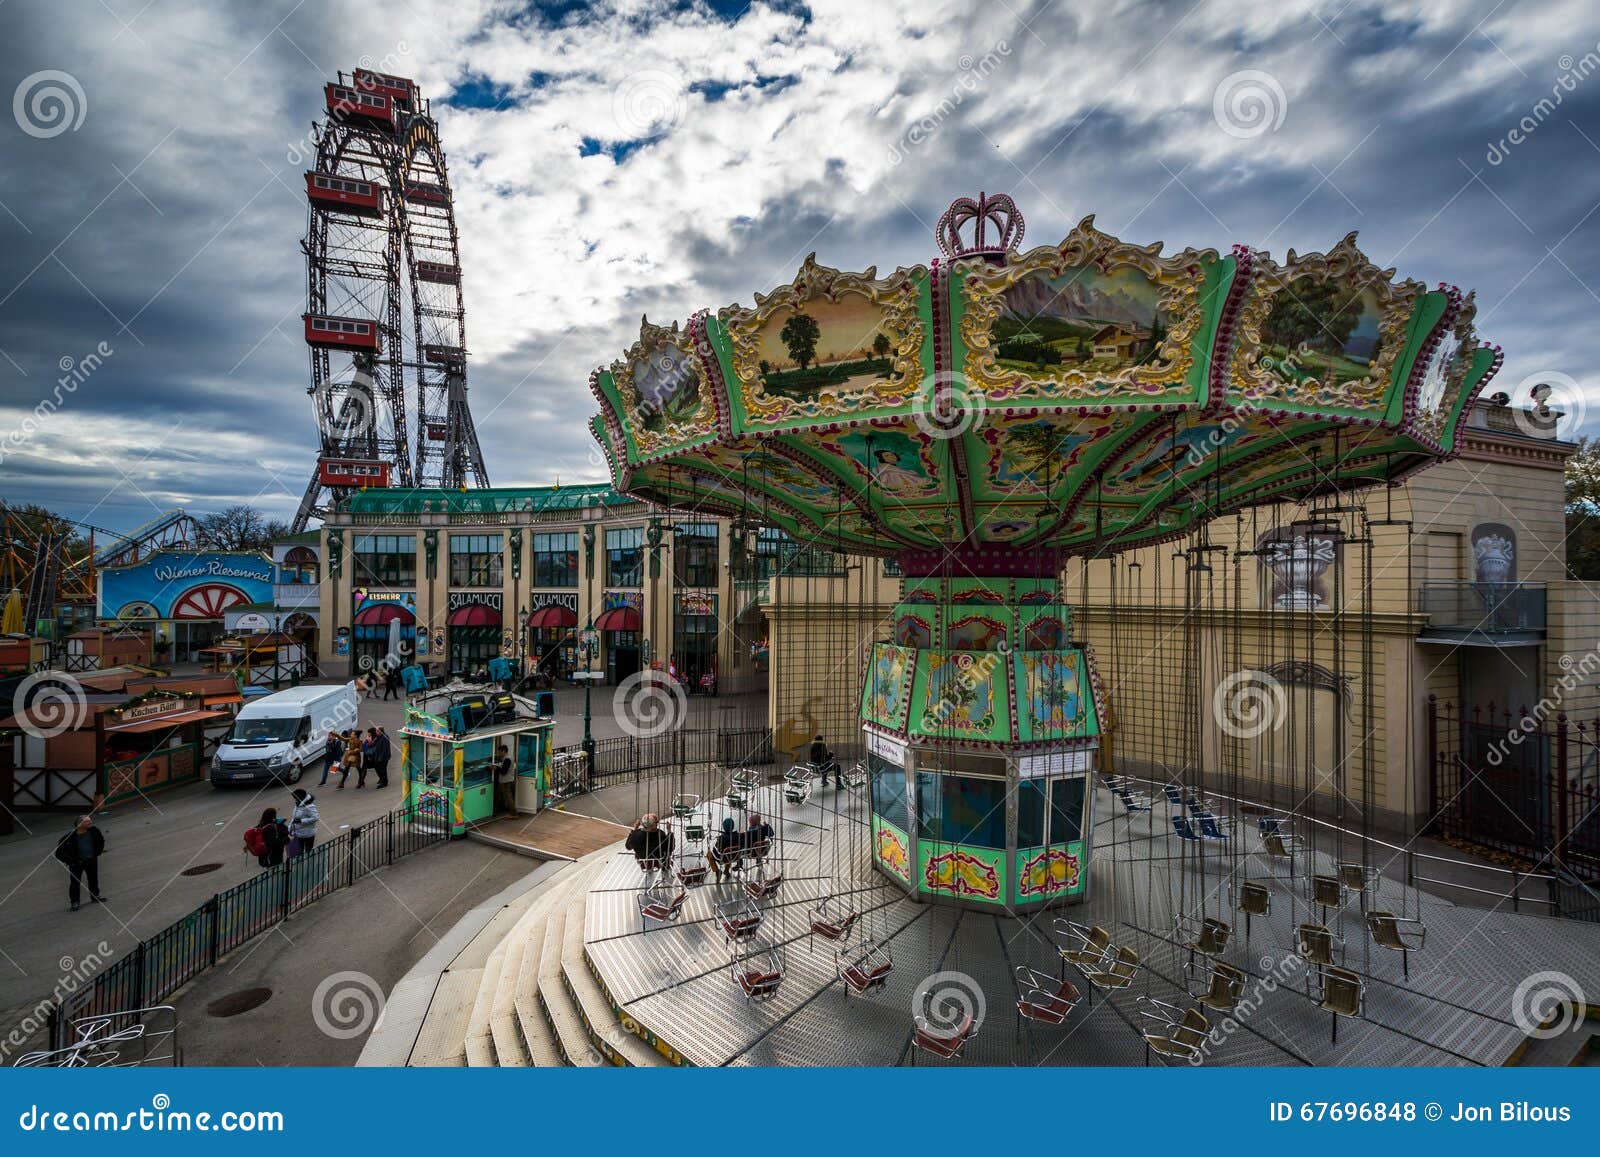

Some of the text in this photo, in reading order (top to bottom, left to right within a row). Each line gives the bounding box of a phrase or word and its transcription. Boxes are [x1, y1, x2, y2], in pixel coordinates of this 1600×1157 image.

[155, 561, 271, 582] Wiener Riesenrad
[450, 593, 501, 611] SALAMUCCI
[533, 594, 577, 612] SALAMUCCI
